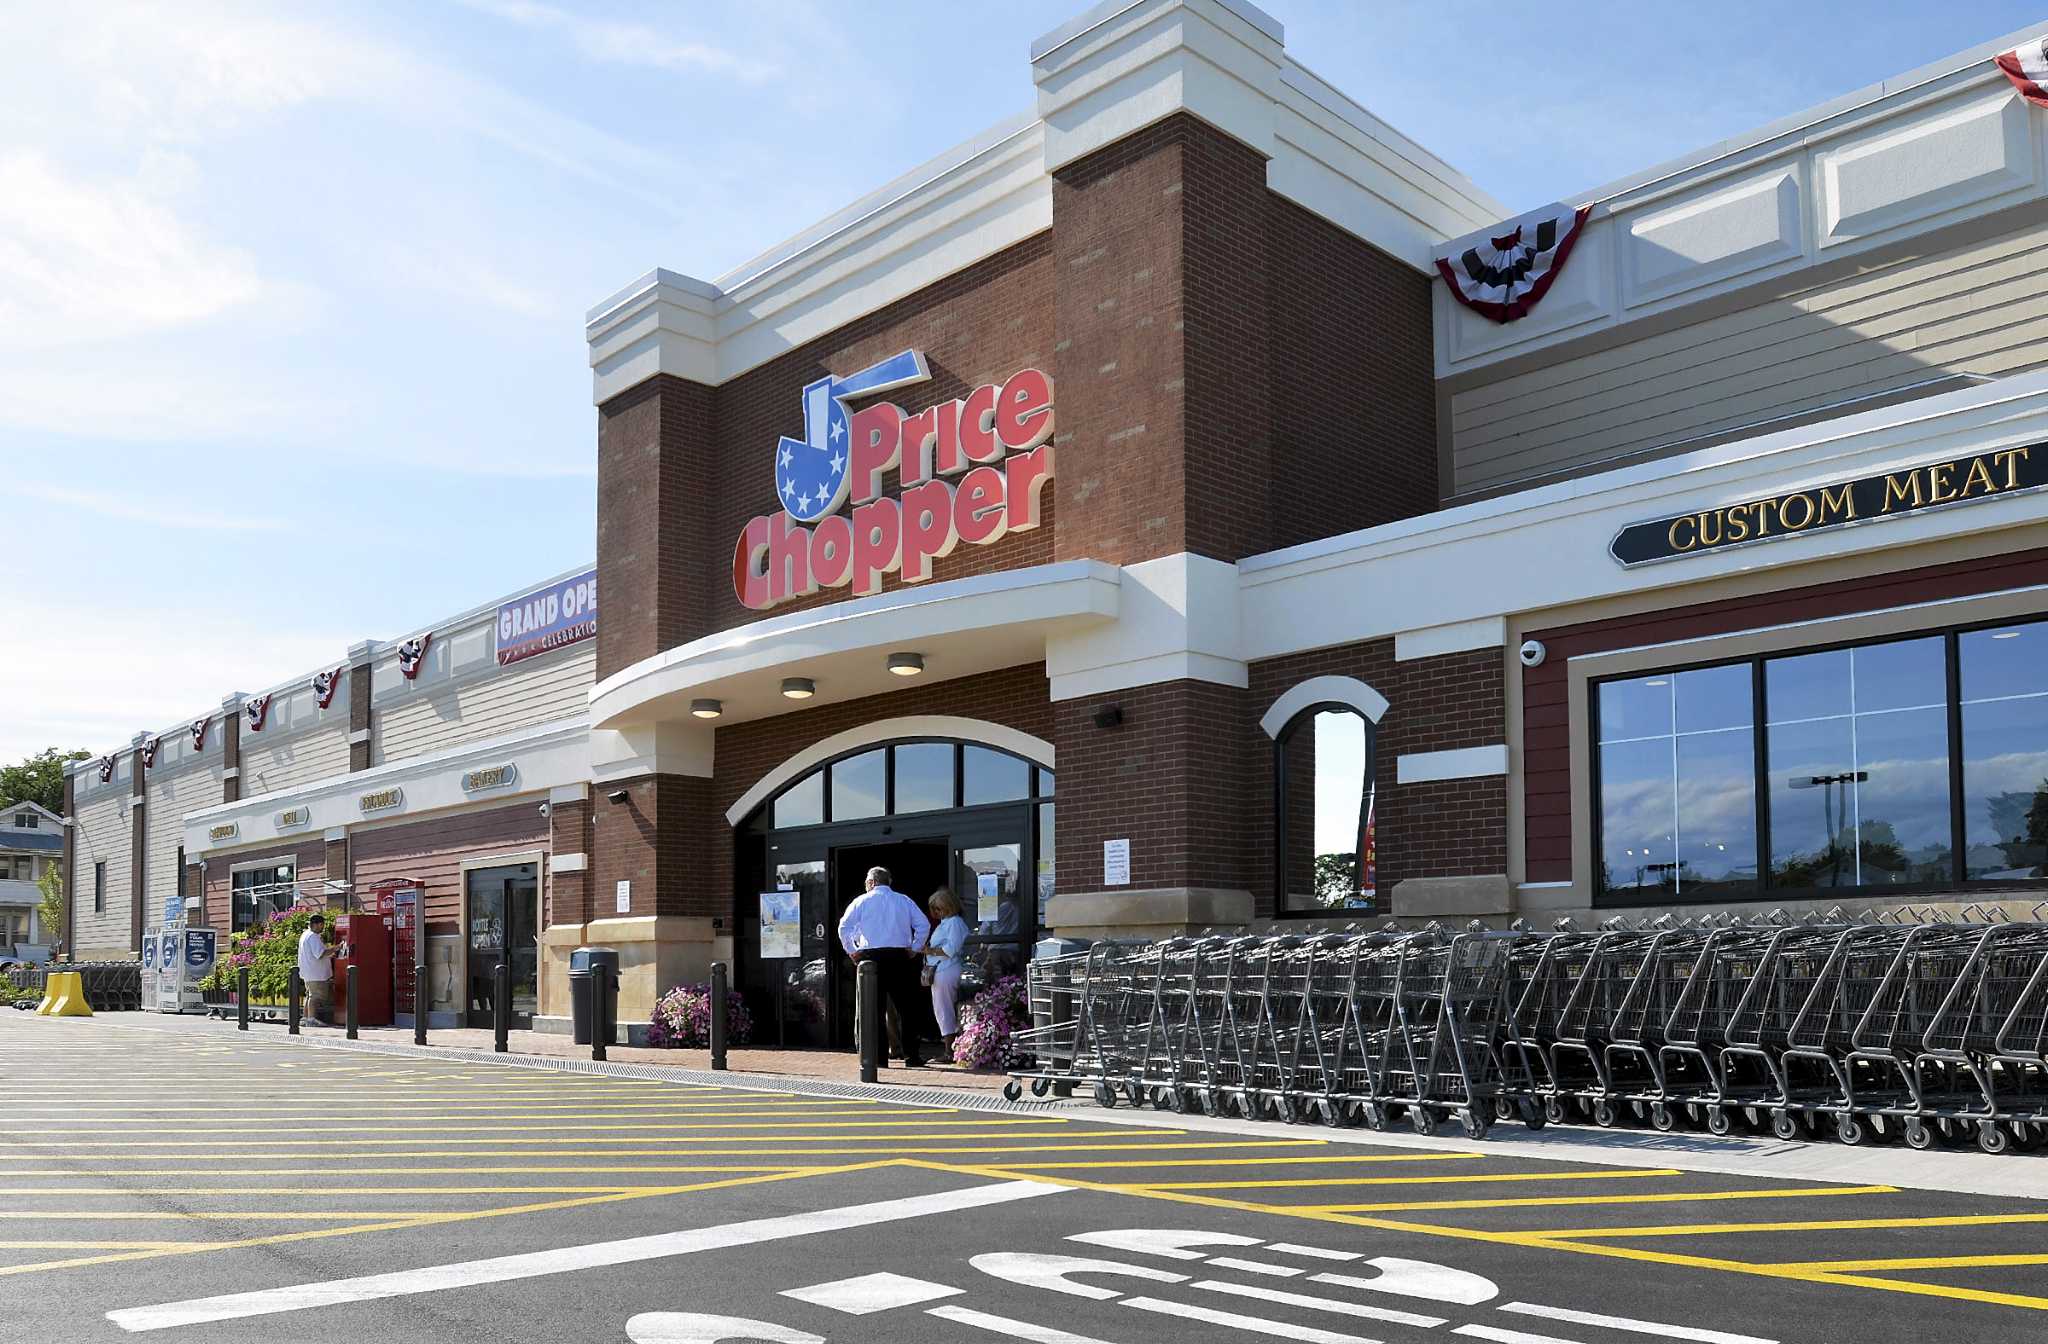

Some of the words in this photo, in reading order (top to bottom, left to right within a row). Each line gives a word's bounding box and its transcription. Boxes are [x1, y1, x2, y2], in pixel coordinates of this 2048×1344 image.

[850, 368, 1054, 504] Price
[733, 443, 1054, 610] Chopper
[1667, 483, 1858, 551] CUSTOM
[1881, 448, 2029, 513] MEAT
[500, 593, 559, 641] GRAND
